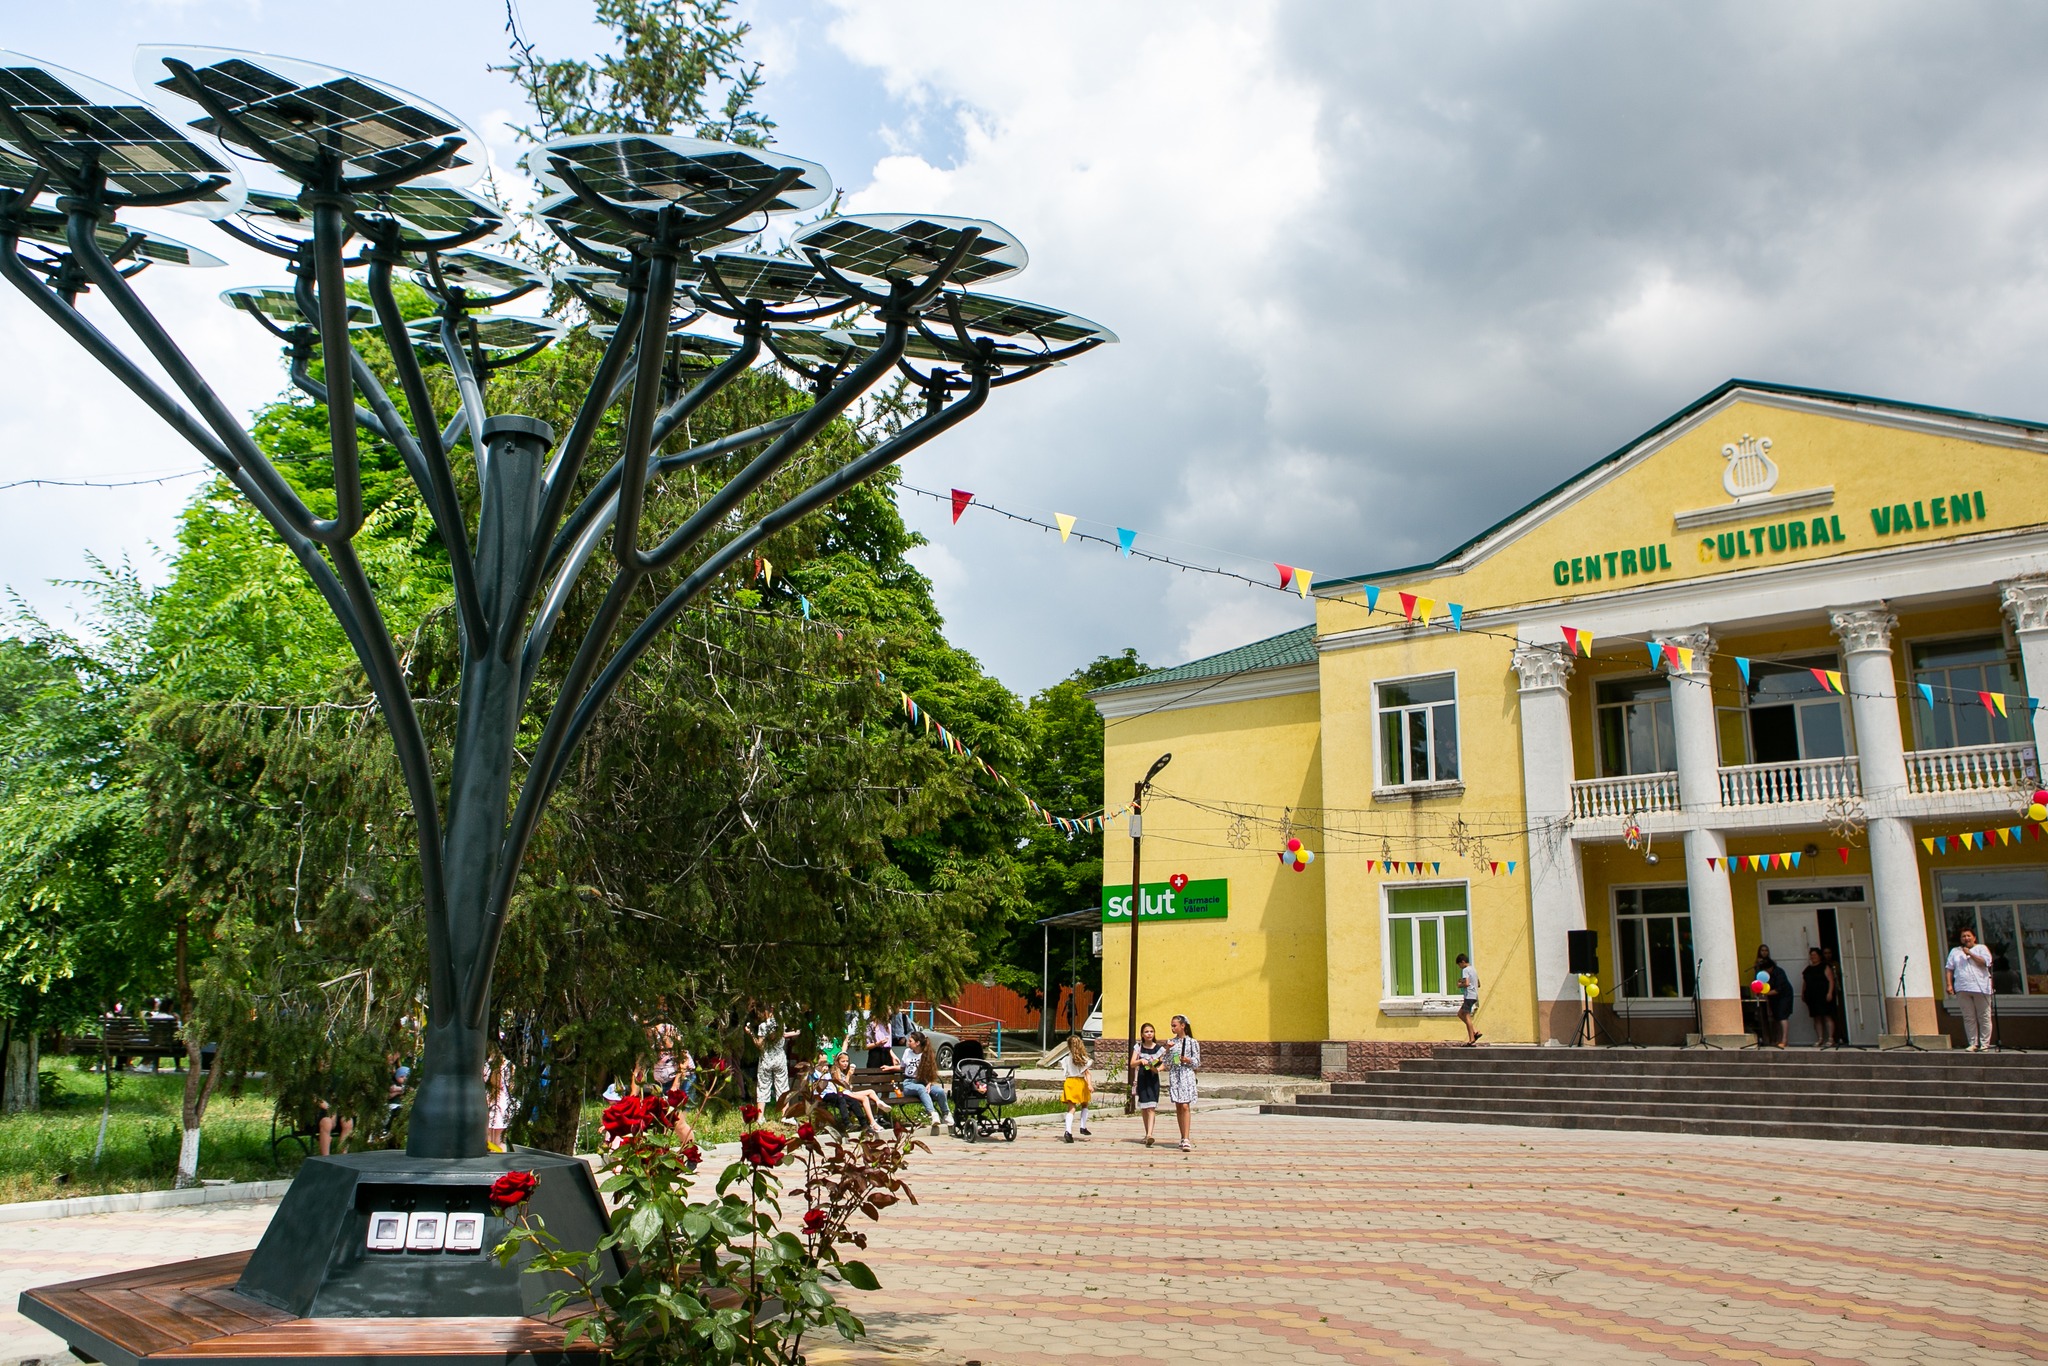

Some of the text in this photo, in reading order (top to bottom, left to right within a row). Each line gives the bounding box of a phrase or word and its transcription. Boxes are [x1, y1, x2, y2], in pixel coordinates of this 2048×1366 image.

[1554, 543, 1672, 586] CENTRUL
[1871, 490, 1986, 535] VALENI
[1108, 888, 1175, 917] salut
[1183, 896, 1220, 904] Farmacie
